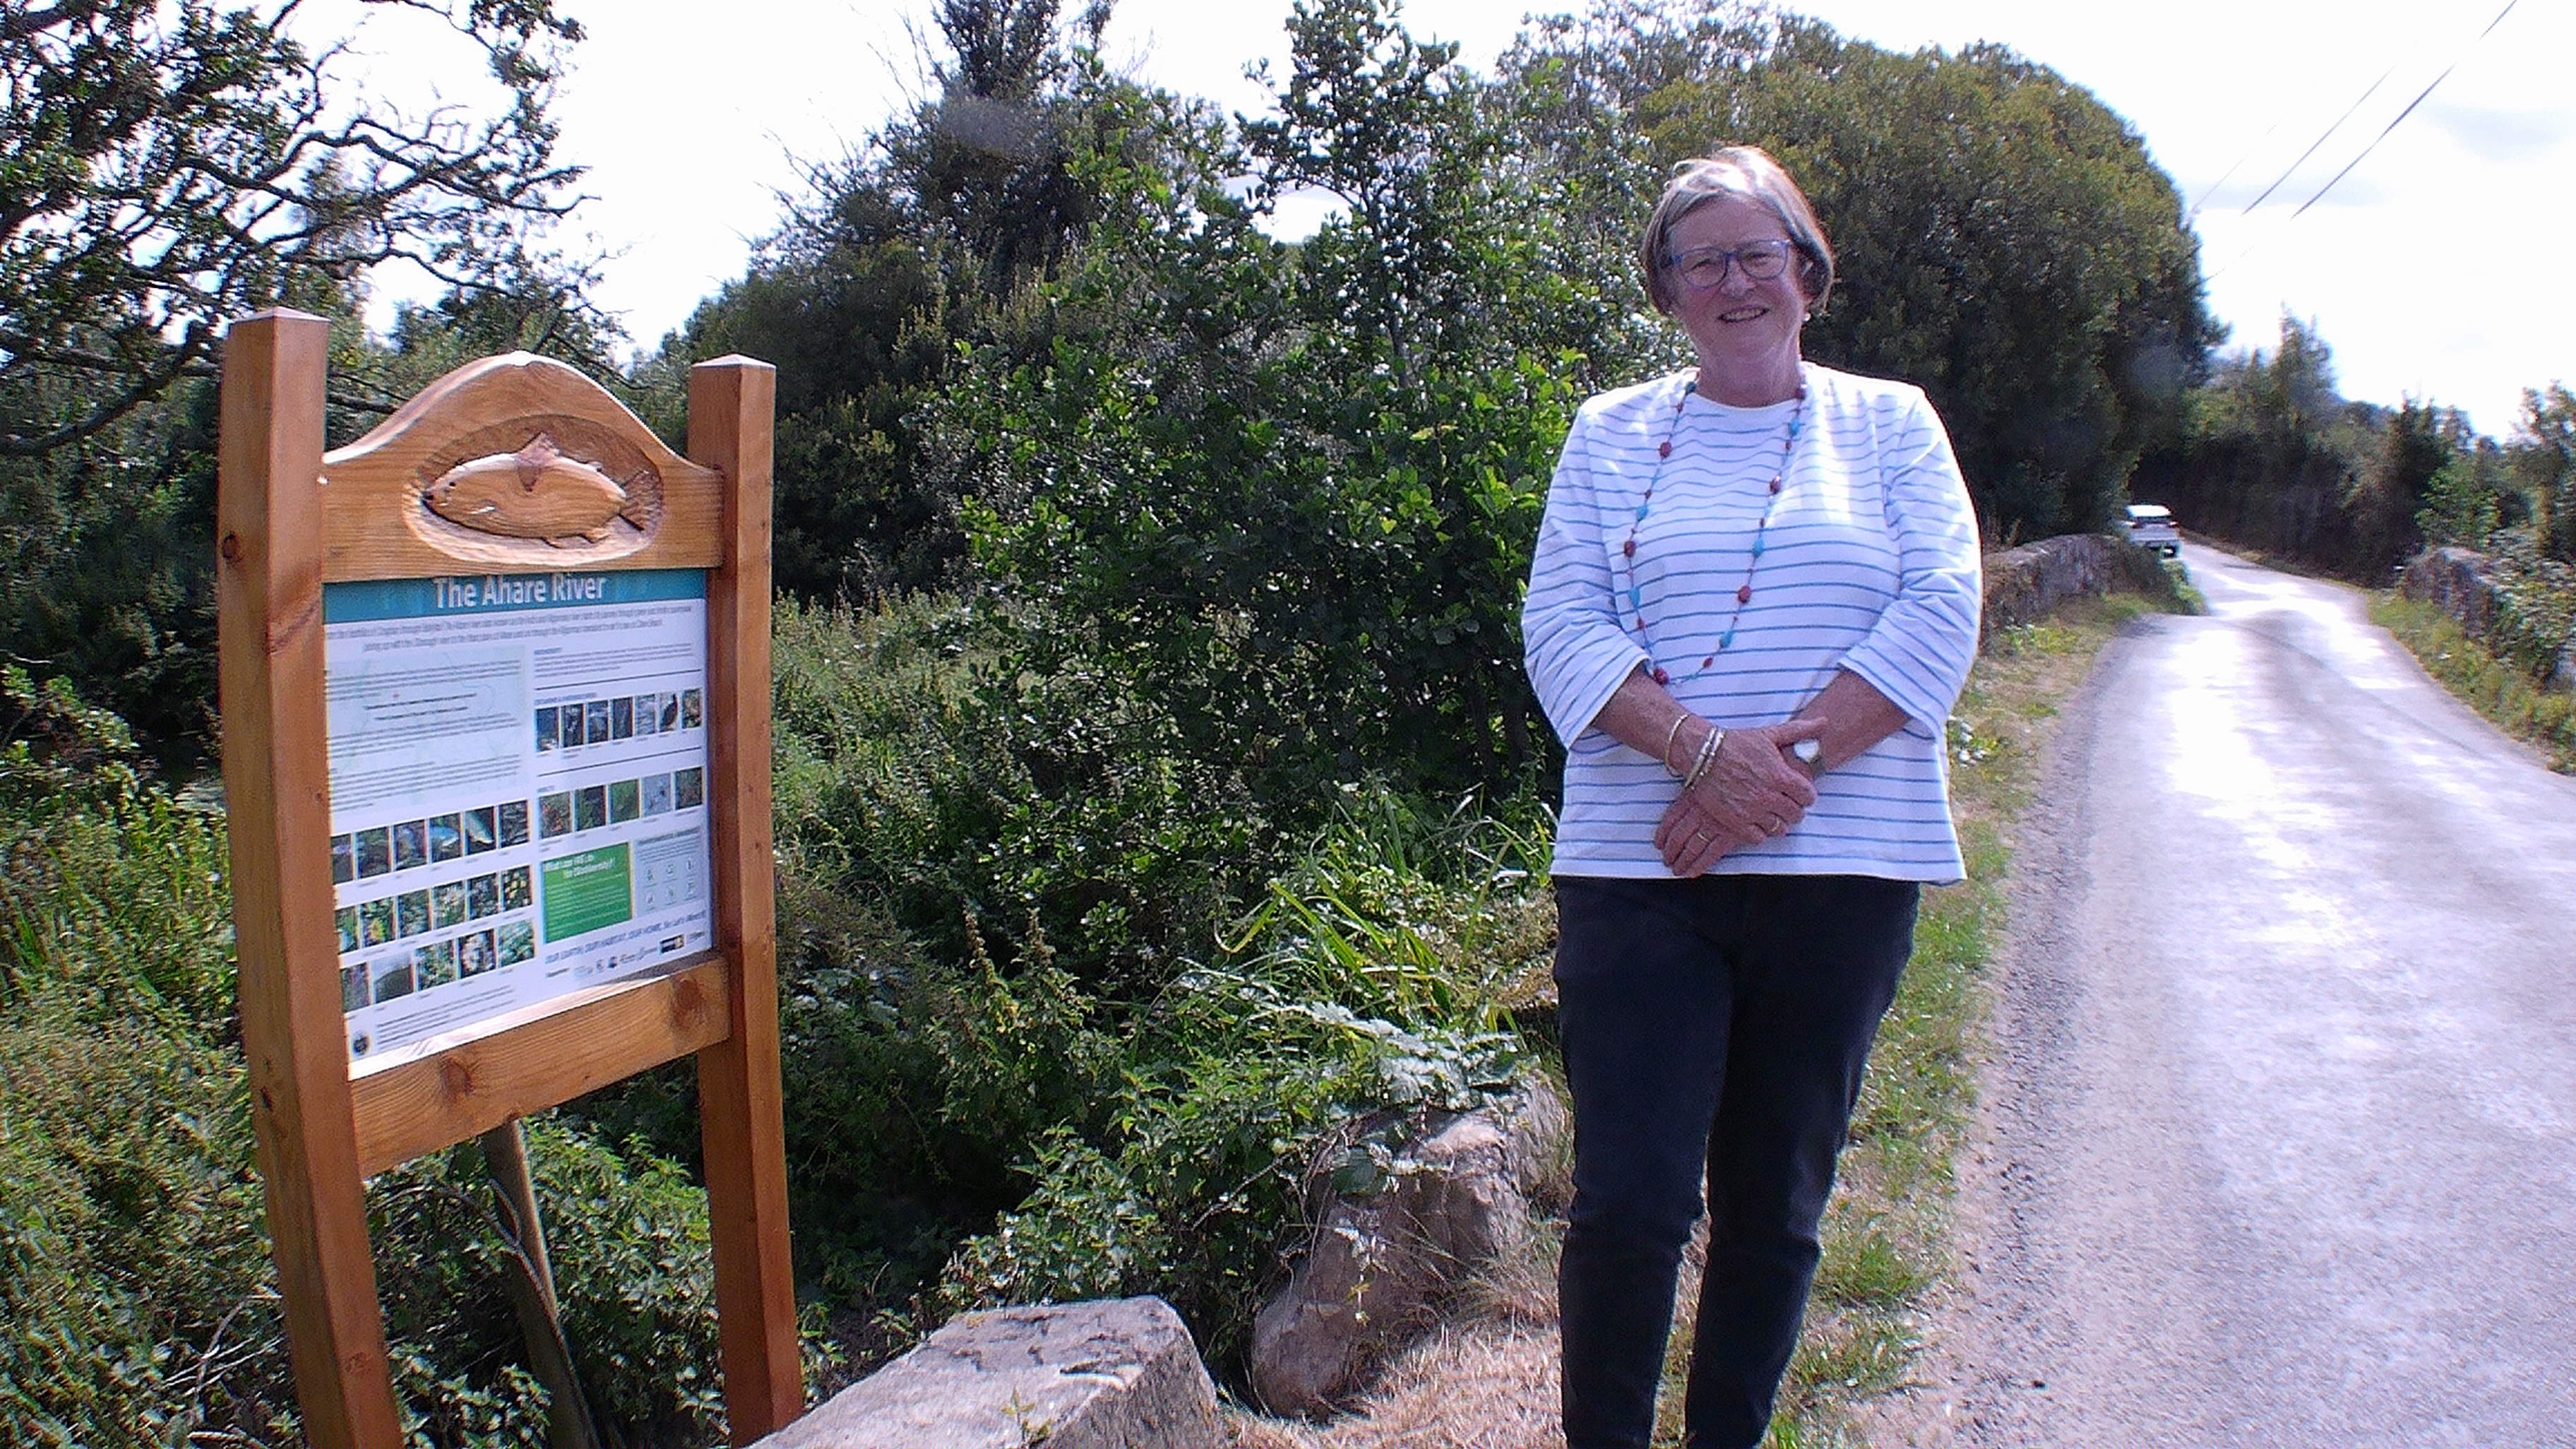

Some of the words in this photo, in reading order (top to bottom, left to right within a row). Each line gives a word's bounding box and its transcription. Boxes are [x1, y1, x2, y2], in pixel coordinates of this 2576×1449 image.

[432, 577, 477, 608] The
[482, 574, 547, 605] Ahare
[552, 573, 607, 600] River
